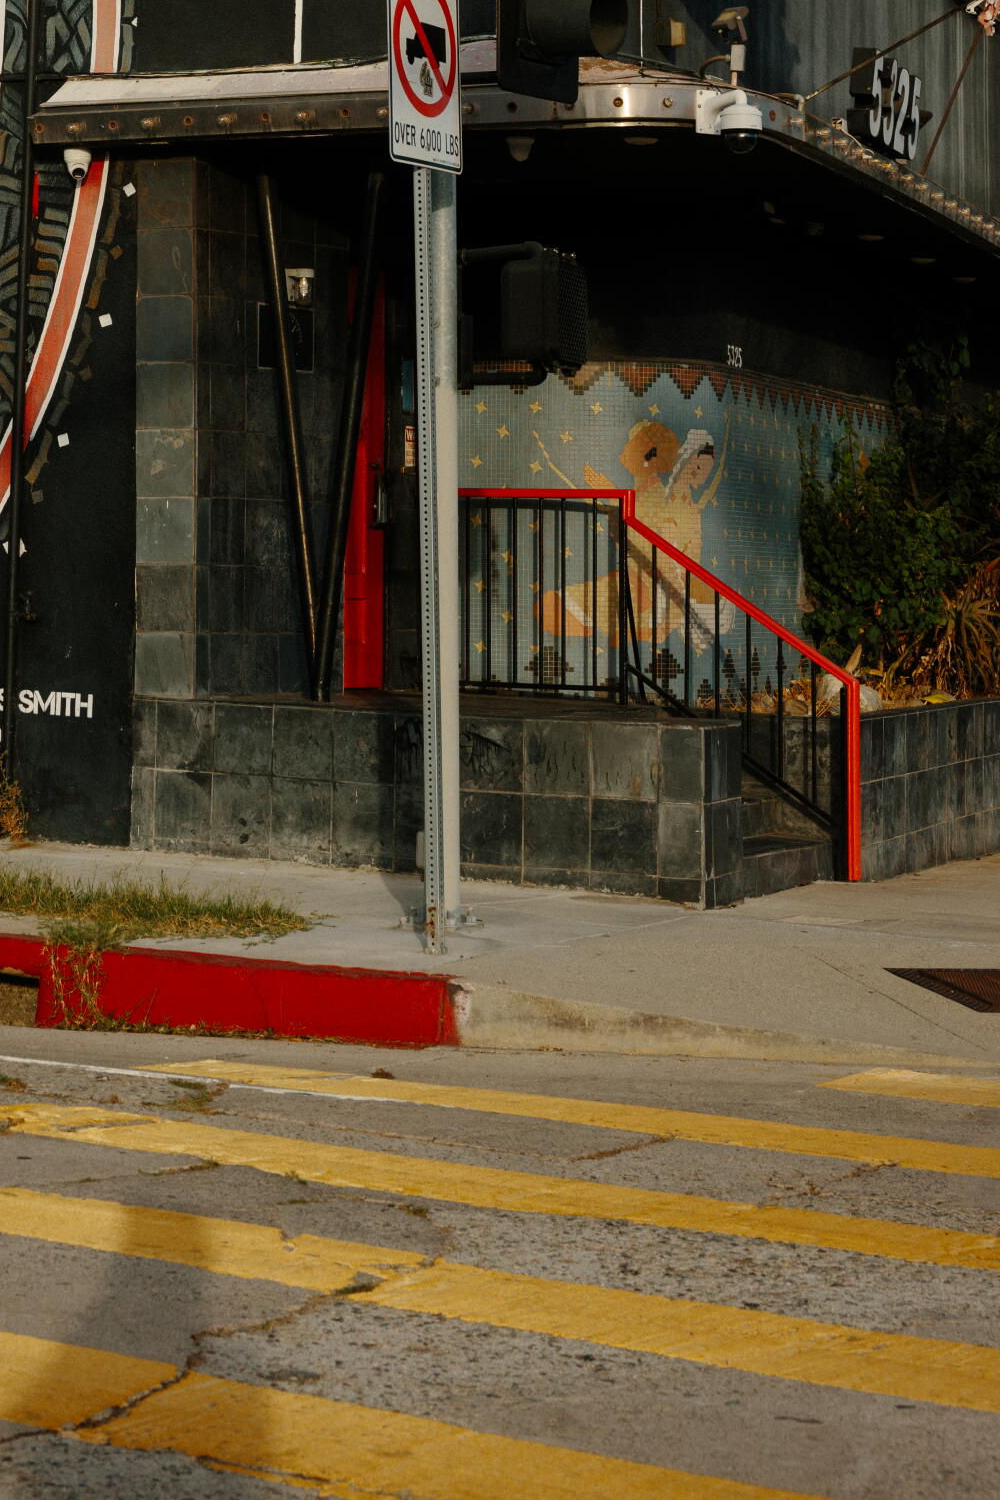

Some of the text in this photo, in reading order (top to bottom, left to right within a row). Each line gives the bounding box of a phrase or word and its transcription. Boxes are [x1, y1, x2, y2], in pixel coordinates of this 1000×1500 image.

[869, 49, 922, 161] 5325
[394, 121, 416, 147] OVER
[445, 133, 459, 157] LBS
[18, 689, 94, 719] SMITH
